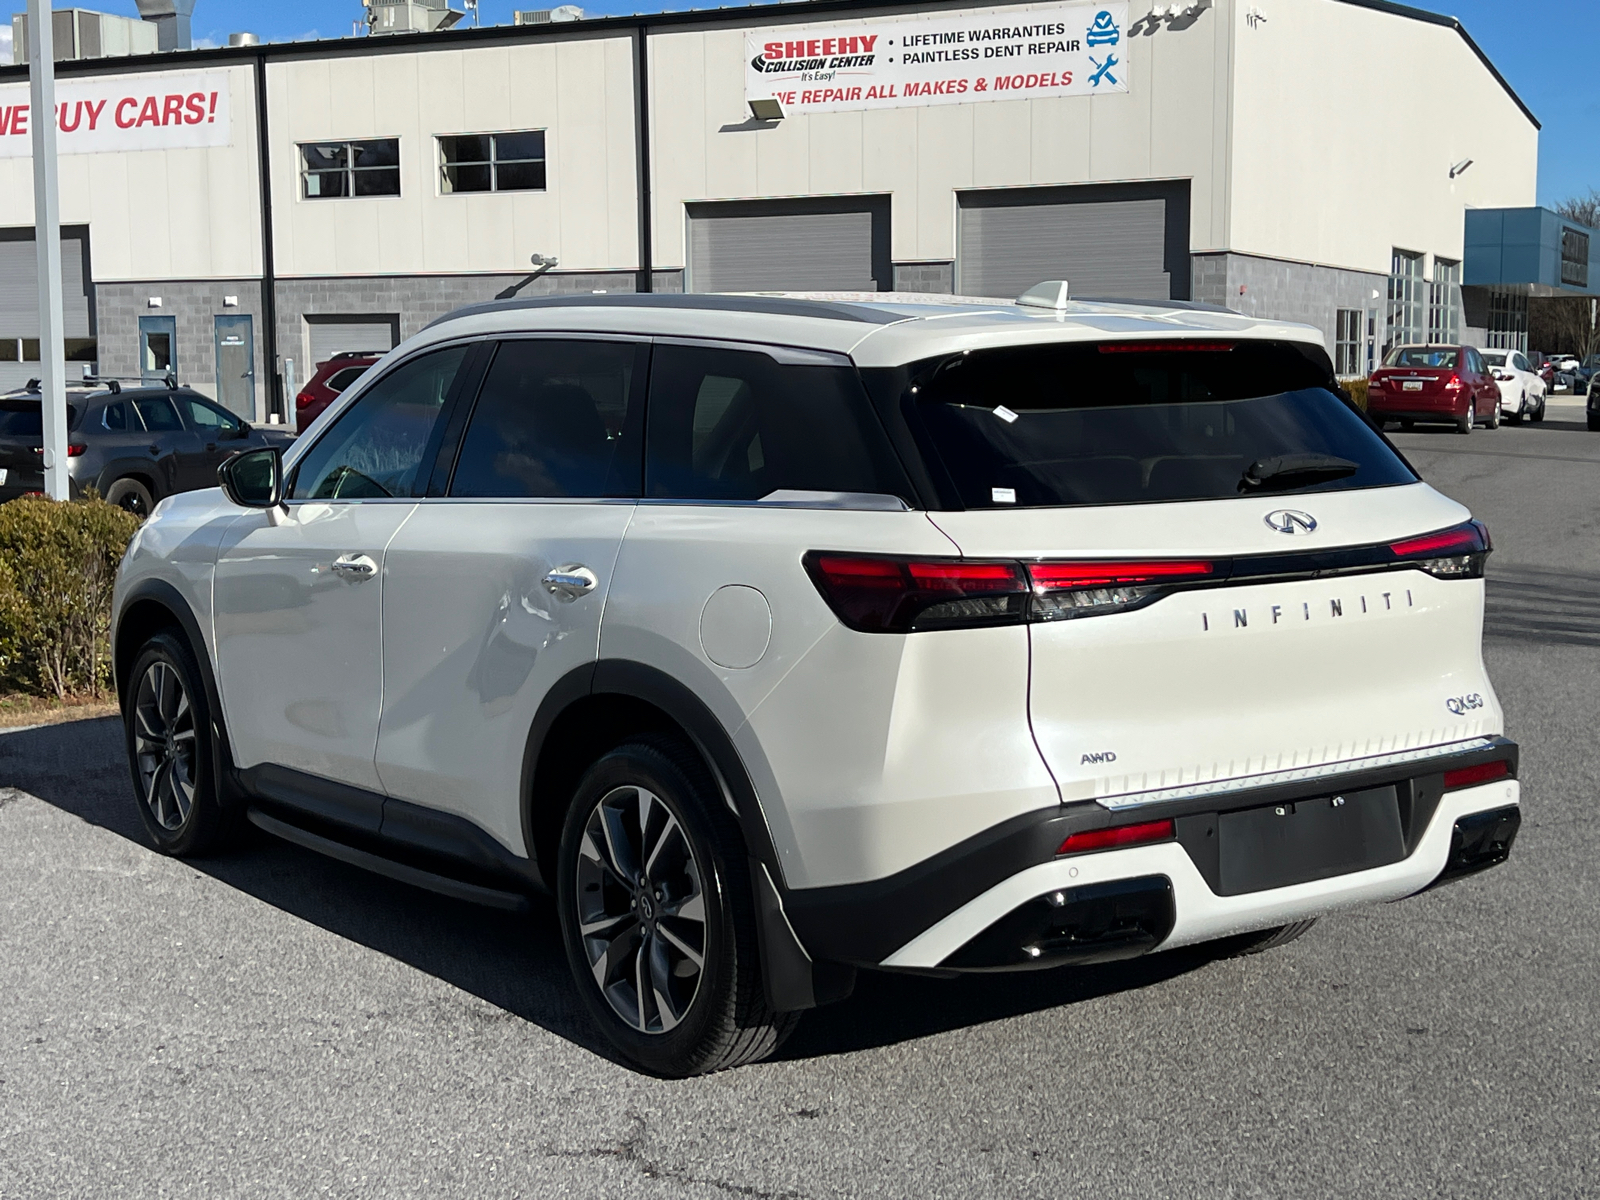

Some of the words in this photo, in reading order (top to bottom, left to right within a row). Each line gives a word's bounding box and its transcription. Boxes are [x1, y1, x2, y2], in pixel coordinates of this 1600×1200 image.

[764, 35, 878, 59] SHEEHY
[902, 31, 965, 47] LIFETIME
[968, 23, 1065, 41] WARRANTIES
[765, 58, 827, 73] COLLISION
[829, 54, 875, 69] CENTER
[902, 48, 979, 64] PAINTLESS
[984, 44, 1024, 59] DENT
[1028, 40, 1080, 55] REPAIR
[801, 72, 813, 81] It's
[814, 70, 836, 82] Easy!
[801, 87, 862, 104] REPAIR
[865, 84, 898, 100] ALL
[903, 79, 968, 97] MAKES
[974, 78, 988, 92] &
[994, 71, 1073, 90] MODELS
[55, 100, 107, 133] UY
[115, 91, 218, 129] CARS!
[1202, 589, 1413, 631] INFINITI
[1446, 692, 1484, 716] QX60
[1080, 751, 1117, 766] AWD
